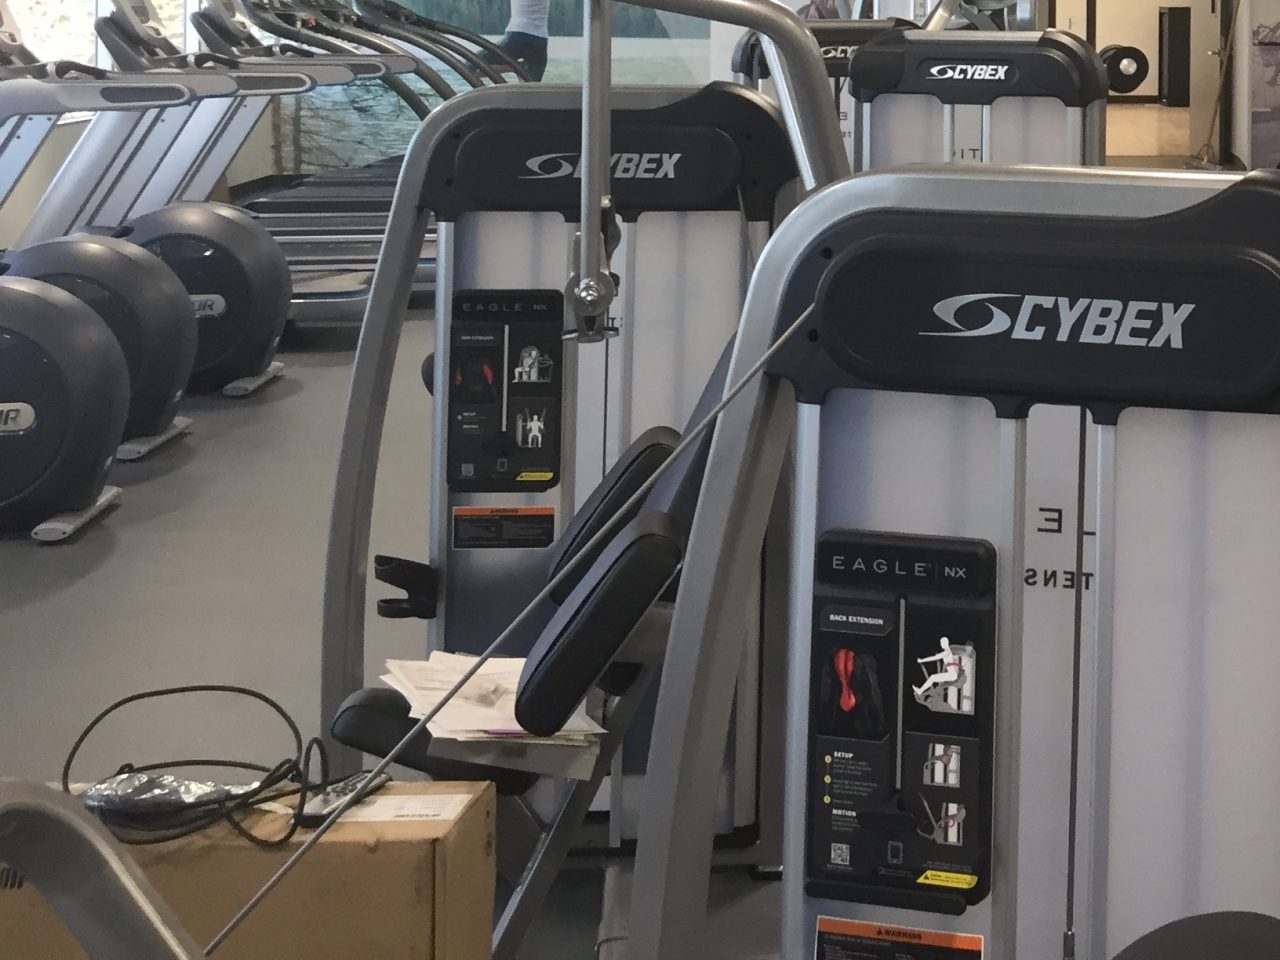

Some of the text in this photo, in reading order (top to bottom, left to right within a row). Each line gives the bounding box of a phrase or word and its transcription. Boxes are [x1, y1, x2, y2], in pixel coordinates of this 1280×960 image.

[953, 64, 1009, 80] CYBEX
[572, 152, 683, 179] BEX
[462, 302, 524, 312] EAGLE
[1010, 293, 1197, 350] CYBEX
[832, 555, 967, 578] EAGLE NX
[848, 615, 884, 626] EXTENSION
